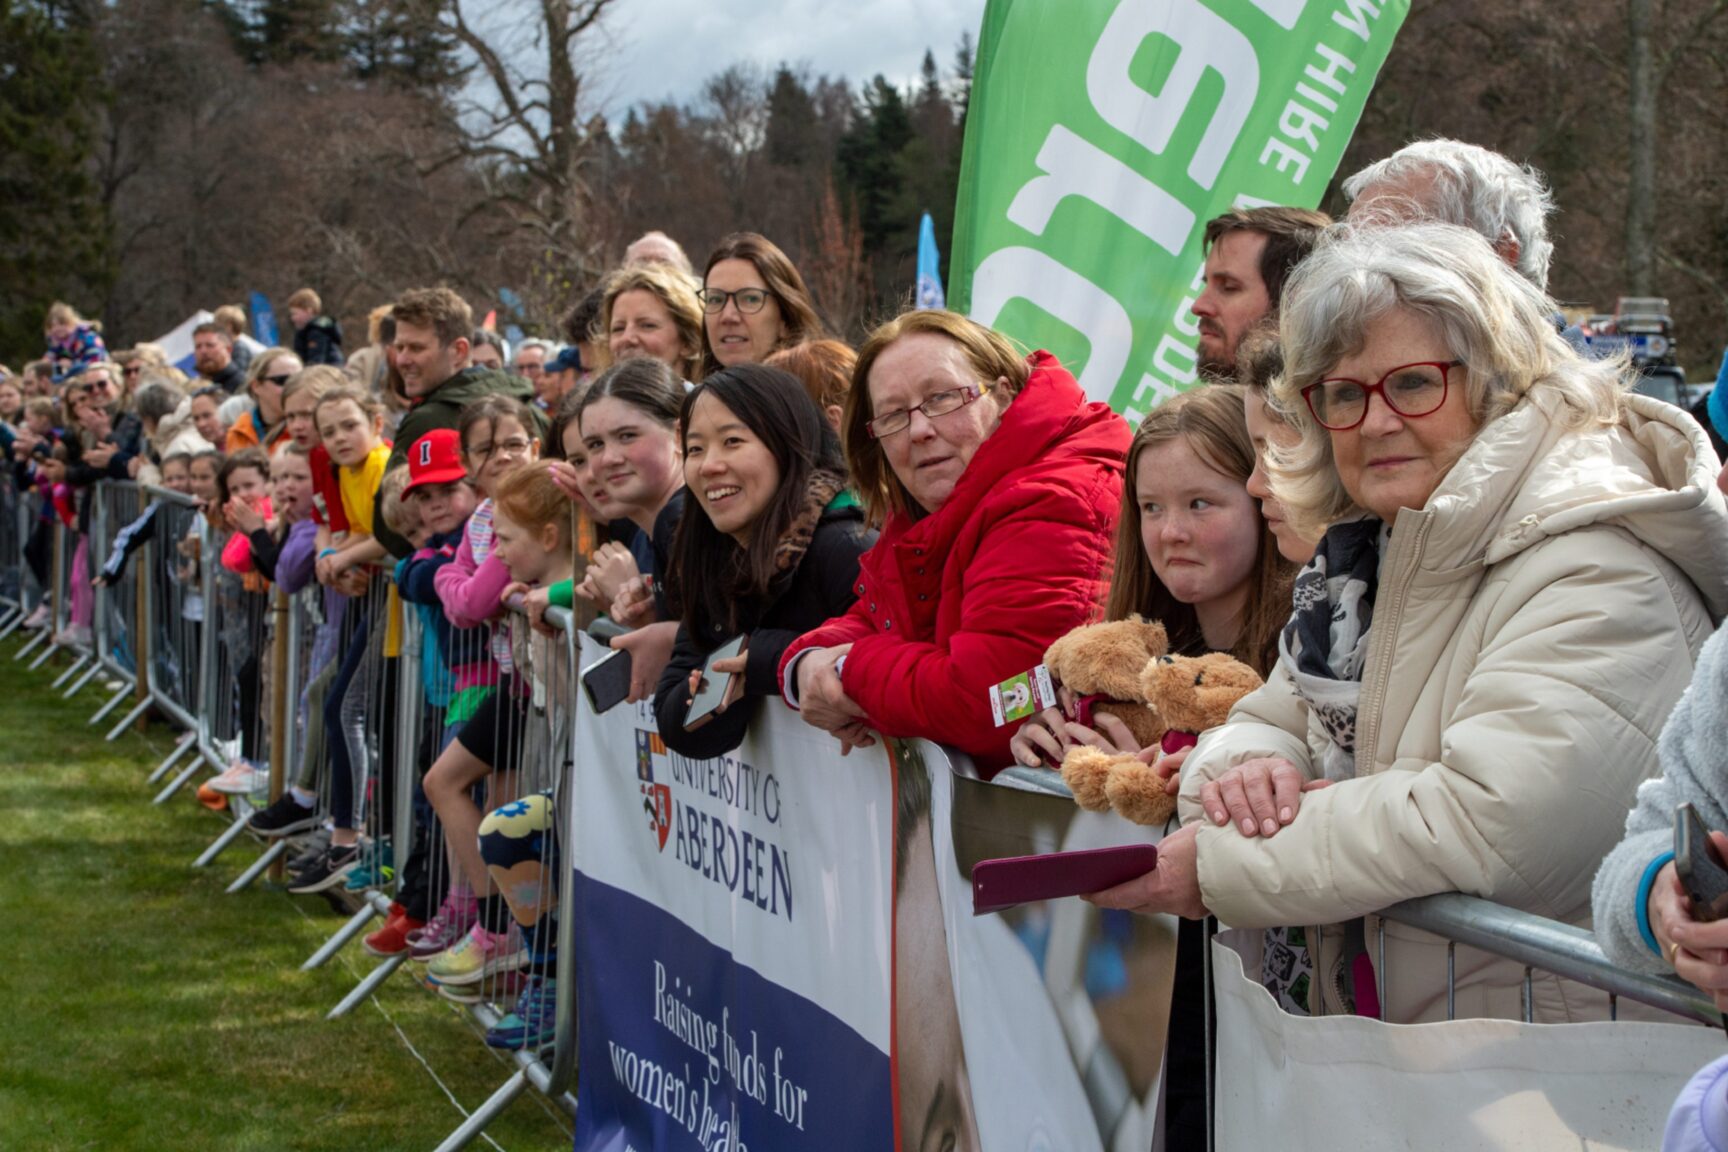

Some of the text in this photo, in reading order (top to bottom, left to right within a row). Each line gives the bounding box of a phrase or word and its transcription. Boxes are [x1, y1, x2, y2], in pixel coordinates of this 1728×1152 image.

[420, 440, 431, 466] I
[671, 751, 760, 816] UNIVERSITY
[675, 799, 793, 923] ABERDEEN
[608, 1040, 699, 1133] women's
[653, 959, 720, 1085] Raising
[773, 1047, 808, 1131] for
